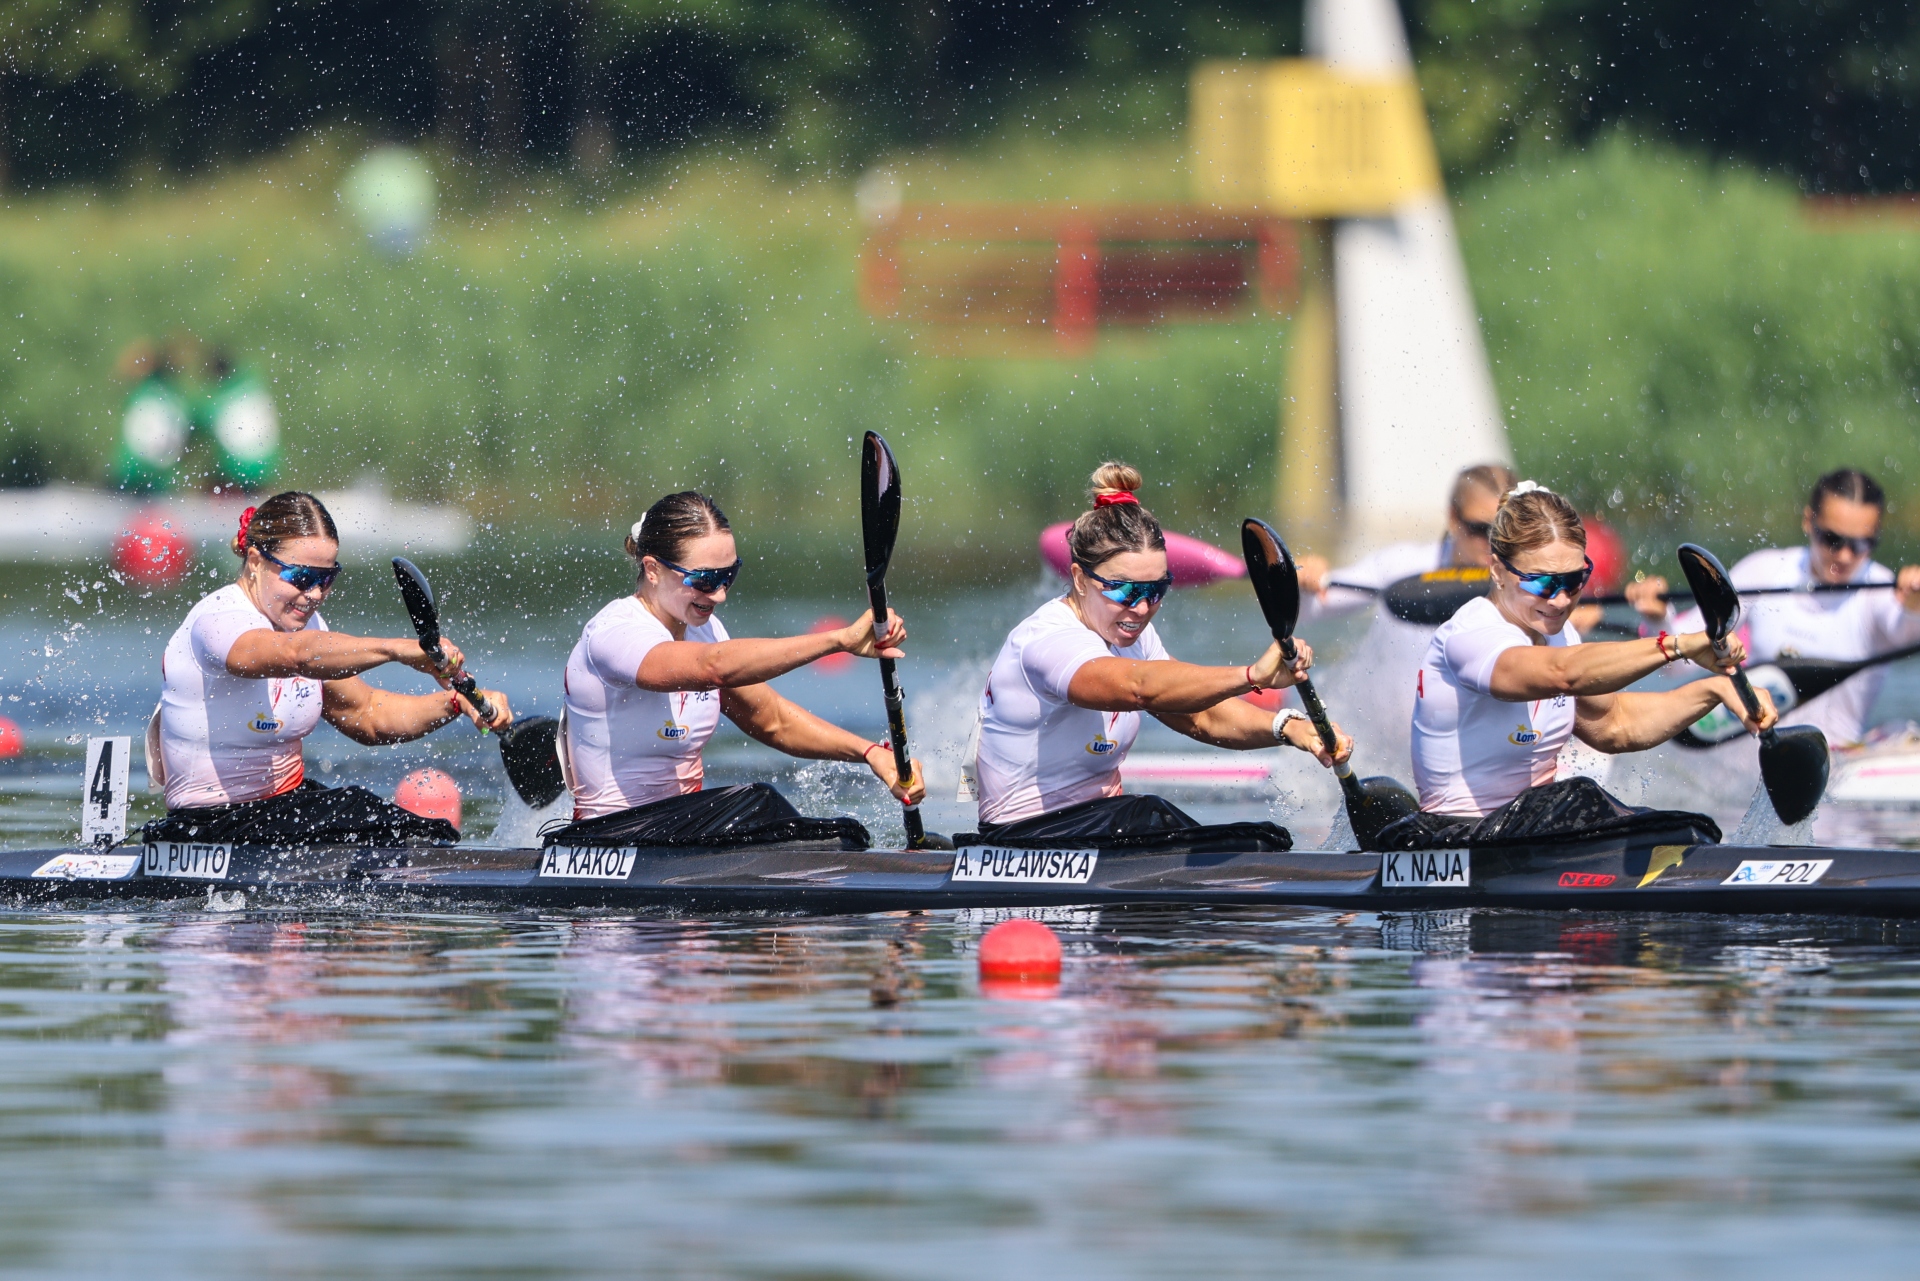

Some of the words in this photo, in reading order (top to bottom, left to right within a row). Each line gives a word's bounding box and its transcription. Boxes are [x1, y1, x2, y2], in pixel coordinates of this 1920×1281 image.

[90, 741, 114, 820] 4
[148, 844, 163, 872] D.
[168, 844, 226, 874] PUTTO
[543, 845, 561, 875] A.
[565, 846, 628, 877] KAKOL
[955, 848, 973, 877] A.
[979, 849, 1091, 879] PUŁAWSKA
[1386, 853, 1404, 882] K.
[1411, 853, 1465, 882] NAJA
[1768, 862, 1818, 883] POL
[1561, 873, 1613, 885] NELO
